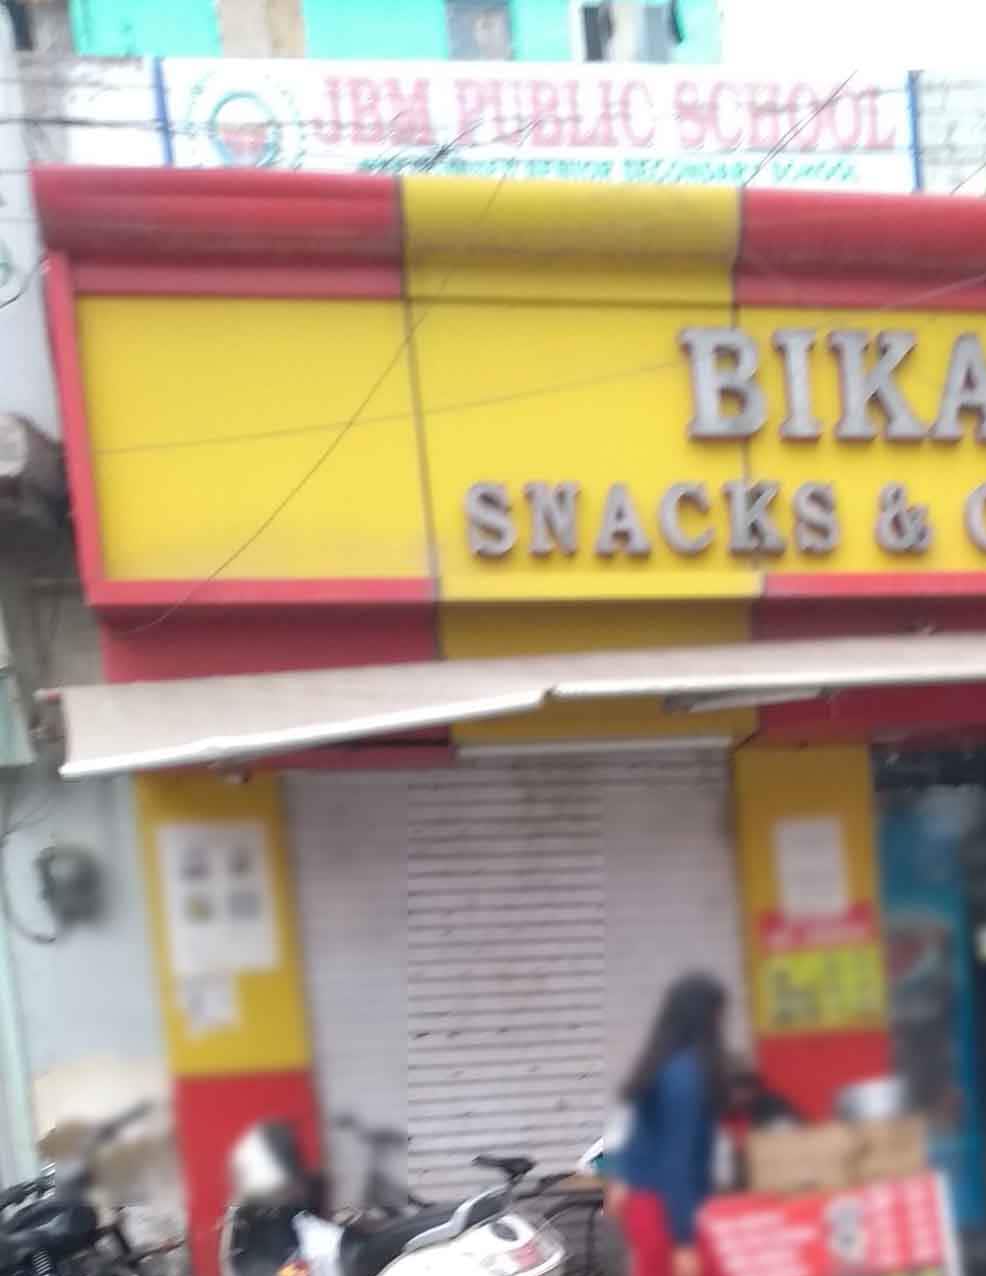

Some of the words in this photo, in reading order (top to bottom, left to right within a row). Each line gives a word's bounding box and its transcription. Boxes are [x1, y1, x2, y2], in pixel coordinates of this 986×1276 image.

[314, 77, 435, 145] JBM
[454, 80, 654, 149] PUBLIC
[674, 81, 897, 151] SCHOOL
[464, 481, 842, 561] SNACKS
[874, 482, 935, 558] &
